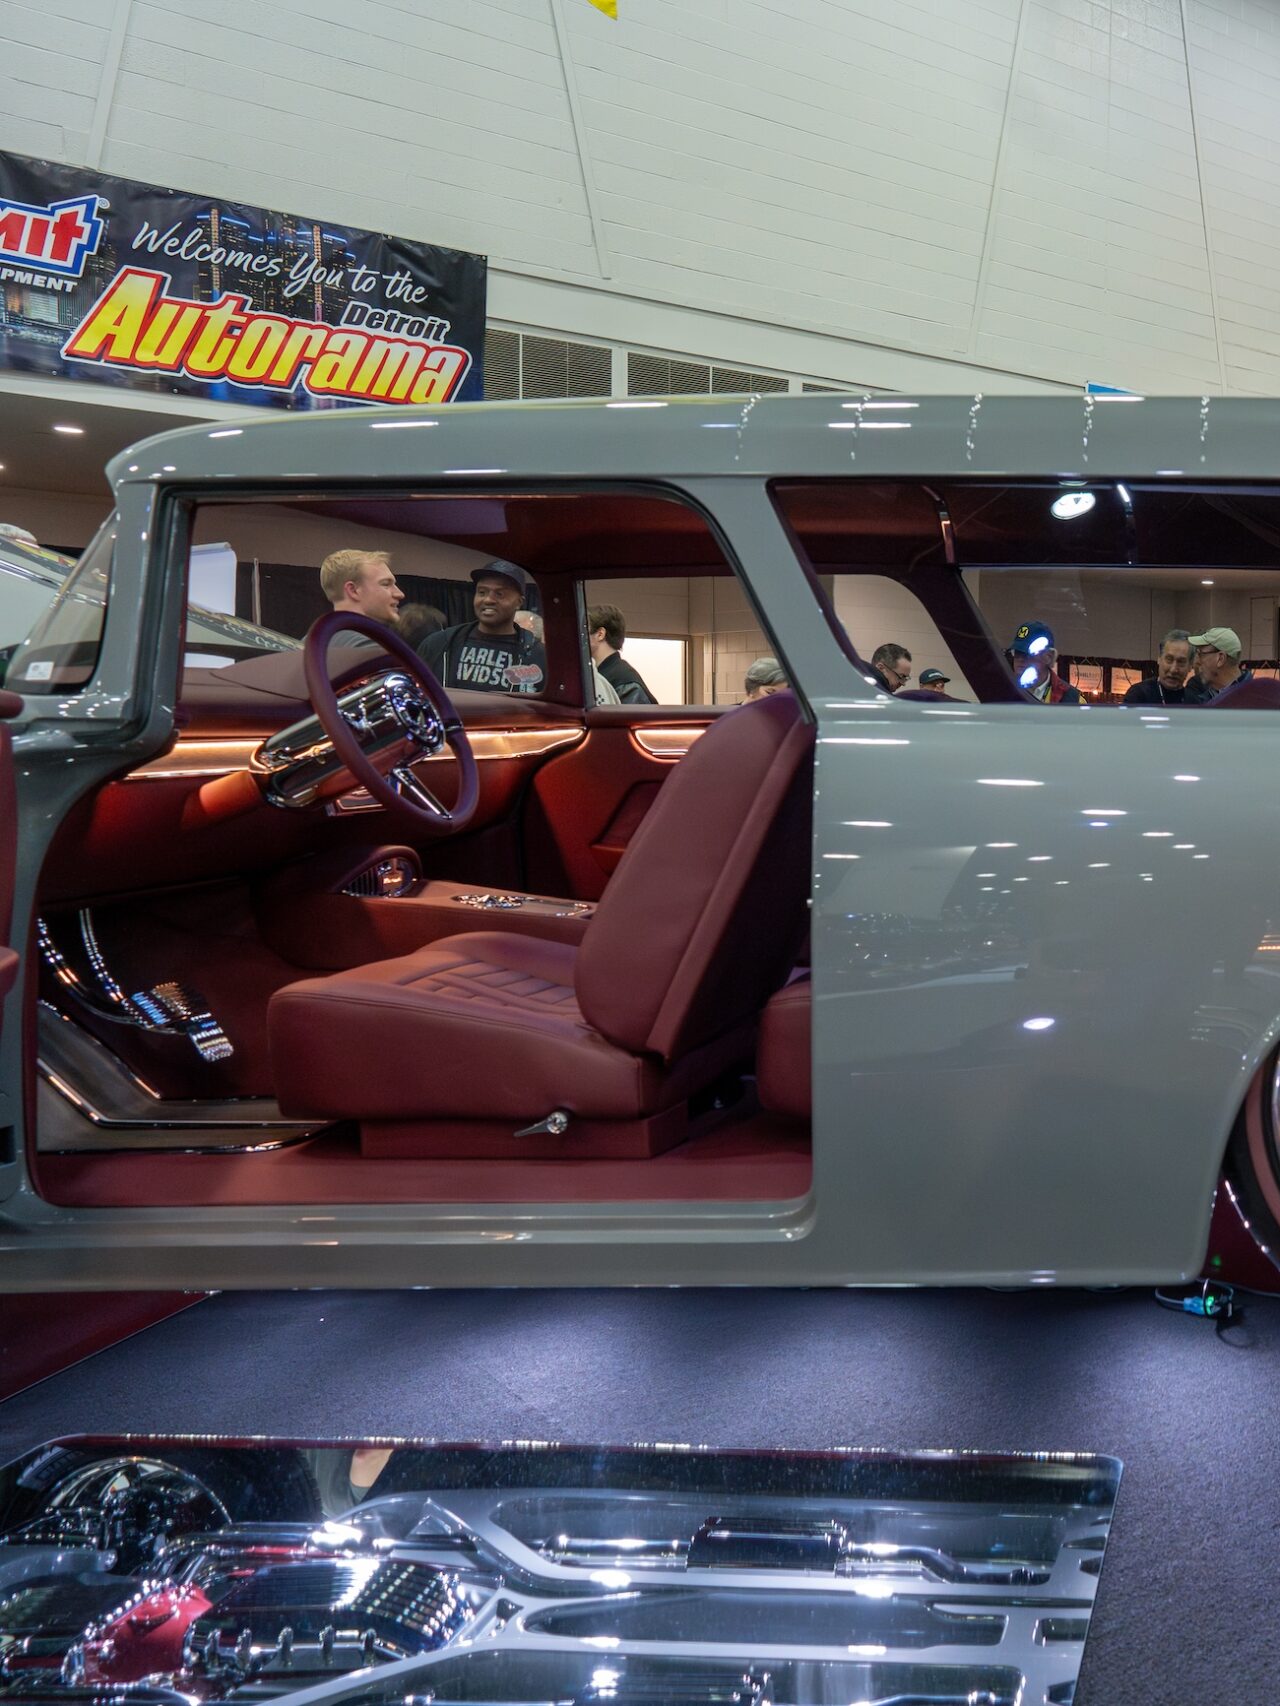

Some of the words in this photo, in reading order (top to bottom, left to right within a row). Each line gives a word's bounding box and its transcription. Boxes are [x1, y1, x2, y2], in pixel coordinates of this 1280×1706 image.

[0, 267, 77, 292] PMENT
[132, 221, 283, 276] Welcomes
[283, 252, 345, 298] You
[348, 264, 380, 293] to
[382, 270, 428, 304] the
[65, 268, 467, 403] Autorama
[343, 304, 449, 342] Detroit
